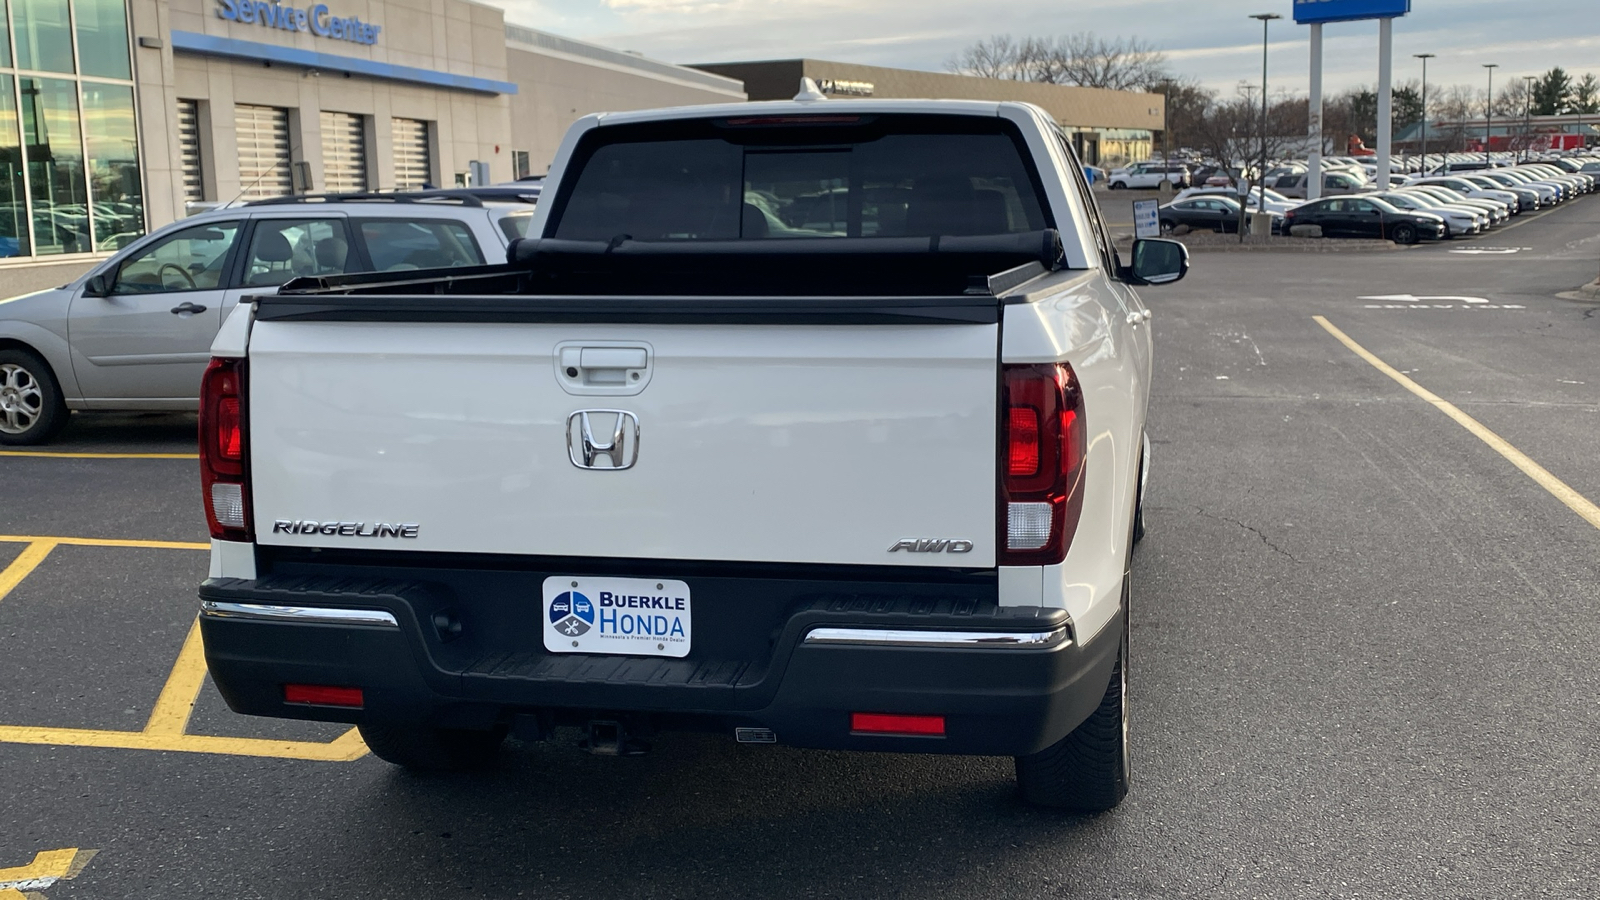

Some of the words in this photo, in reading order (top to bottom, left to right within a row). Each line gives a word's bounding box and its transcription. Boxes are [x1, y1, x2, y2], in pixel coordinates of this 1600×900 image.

[216, 0, 308, 32] Service
[308, 4, 381, 45] Center
[273, 519, 420, 539] RIDGELINE
[887, 538, 974, 553] AWD
